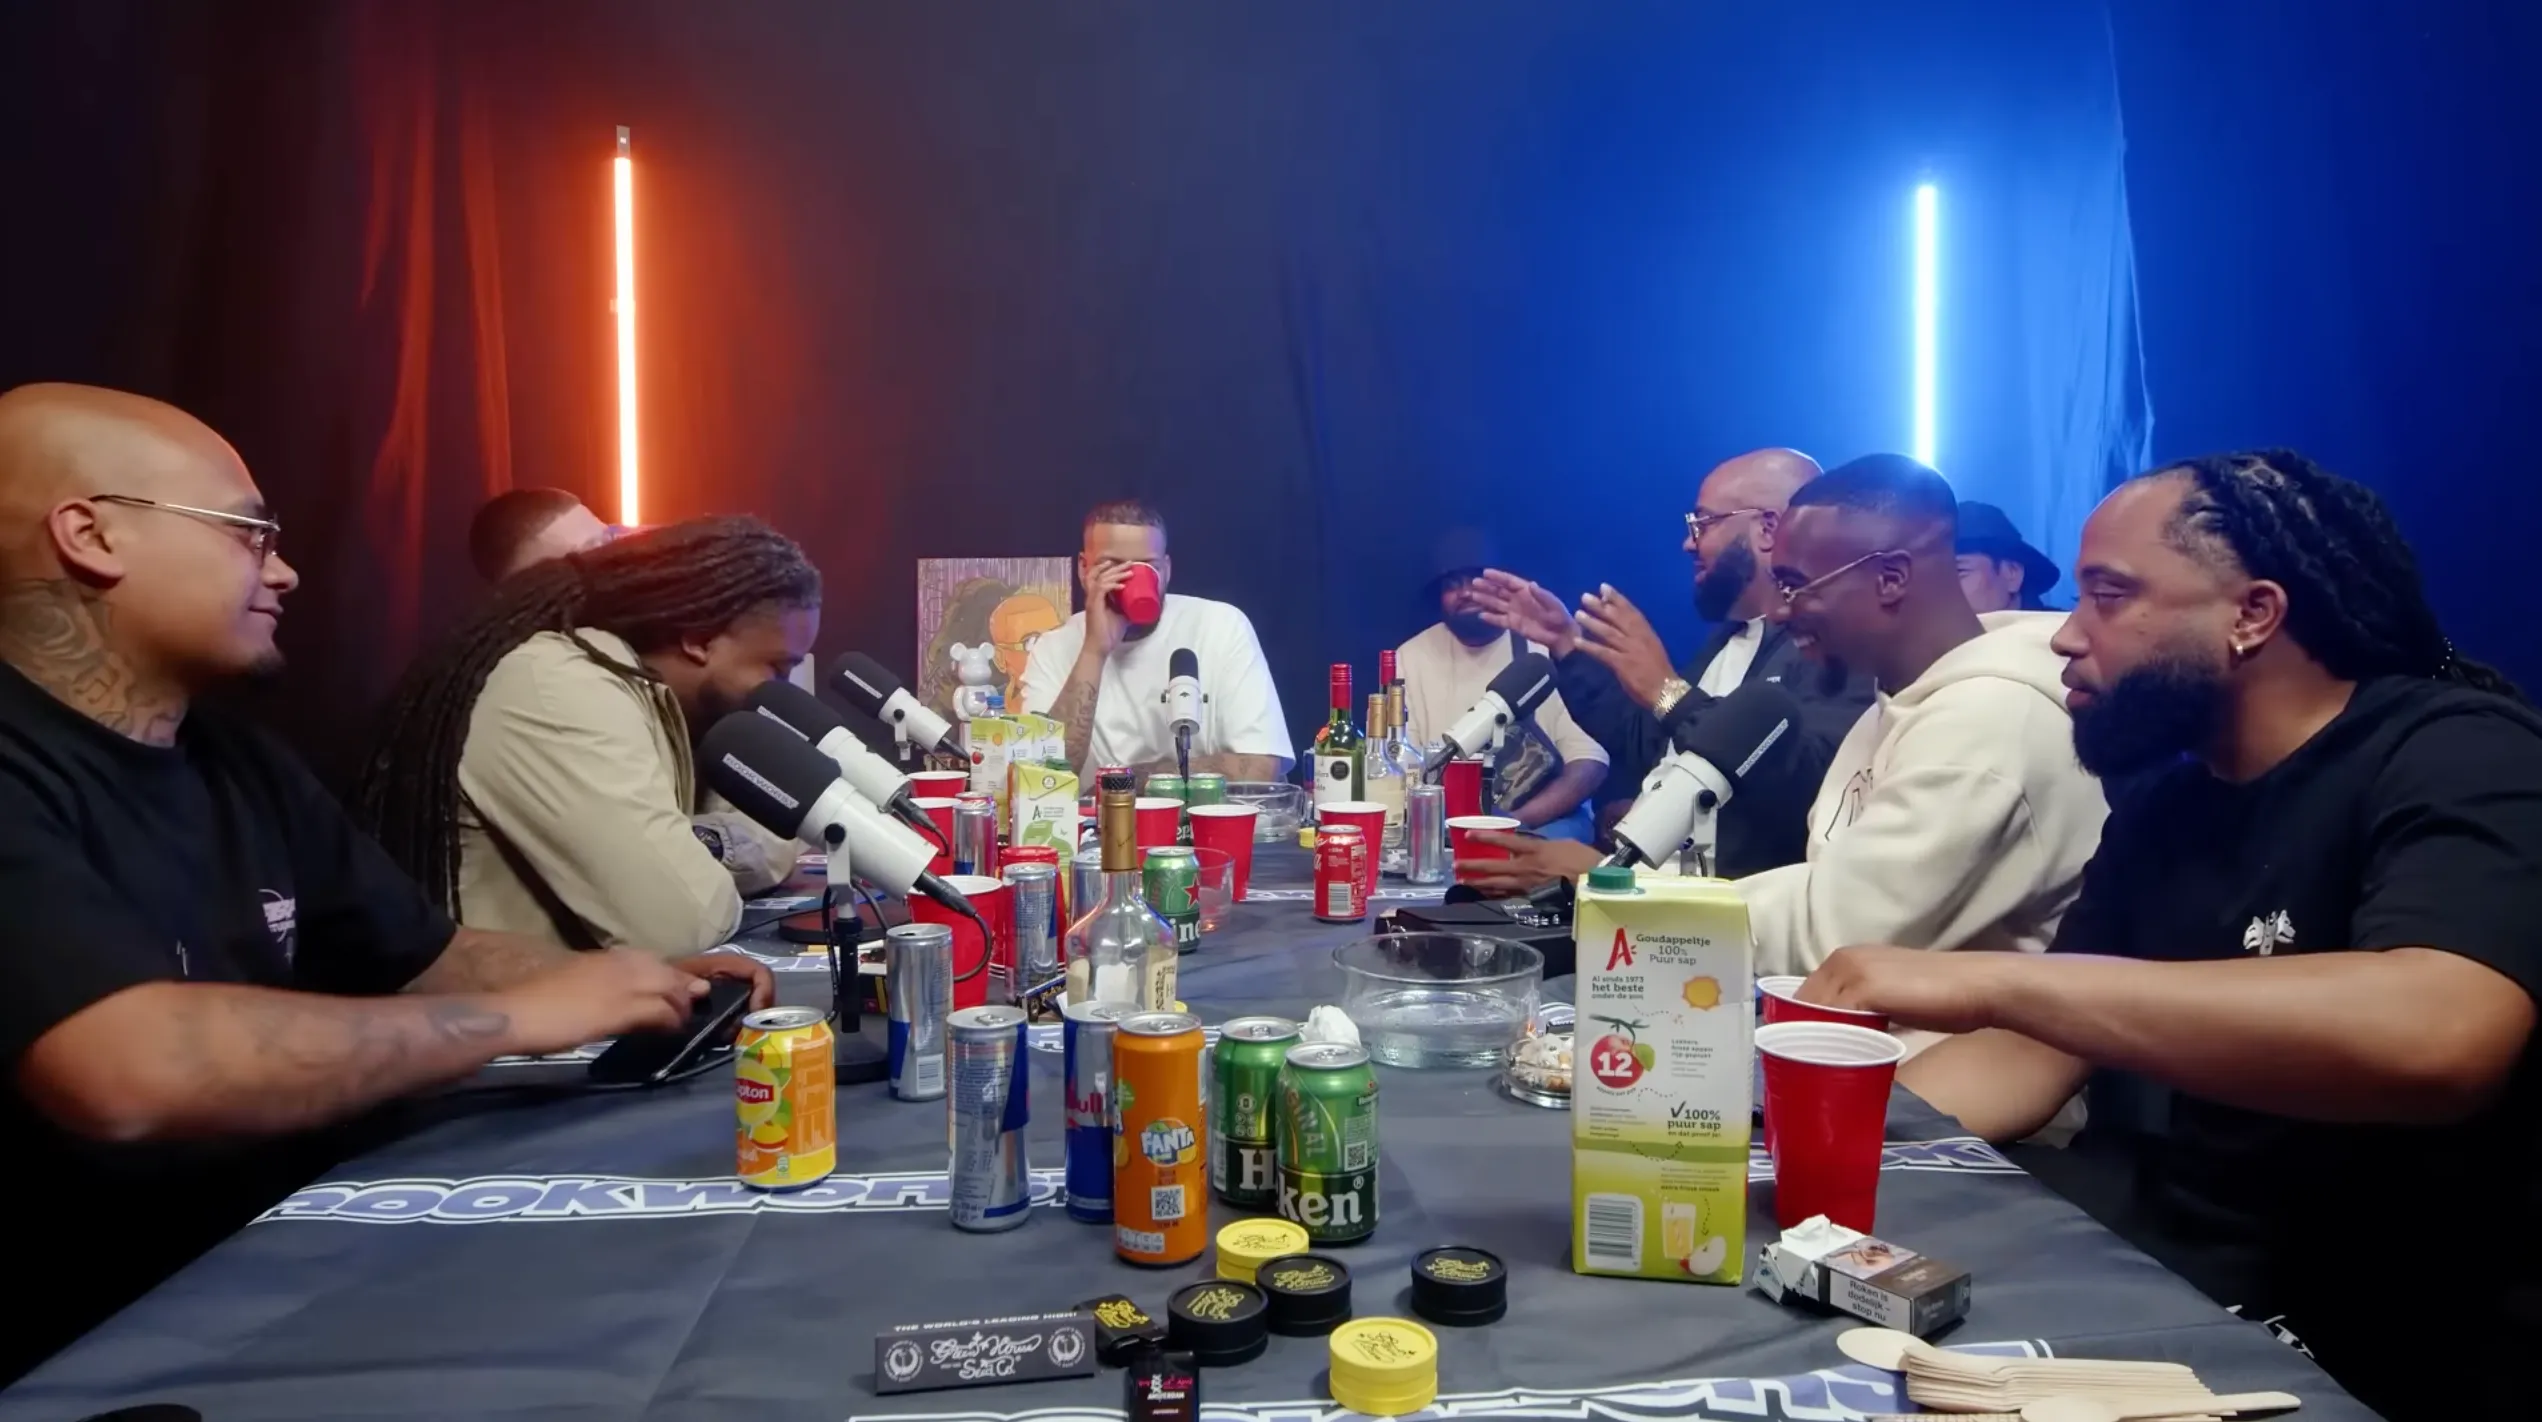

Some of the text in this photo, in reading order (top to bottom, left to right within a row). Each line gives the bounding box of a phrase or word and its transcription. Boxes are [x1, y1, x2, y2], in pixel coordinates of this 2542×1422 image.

[1636, 933, 1711, 947] Goudappeltje
[1649, 954, 1697, 966] Puur sap
[1592, 983, 1644, 993] het beste
[1598, 1051, 1633, 1078] 12
[1684, 1109, 1721, 1121] 100%
[1667, 1119, 1722, 1132] puur sap
[1140, 1126, 1195, 1155] FANTA
[250, 1175, 1065, 1224] ROOKWOR
[1850, 1280, 1889, 1302] Roken is
[1852, 1302, 1887, 1322] stop nu
[894, 1324, 919, 1332] THE
[923, 1320, 980, 1330] WORLD'S
[985, 1314, 1039, 1325] LEADING
